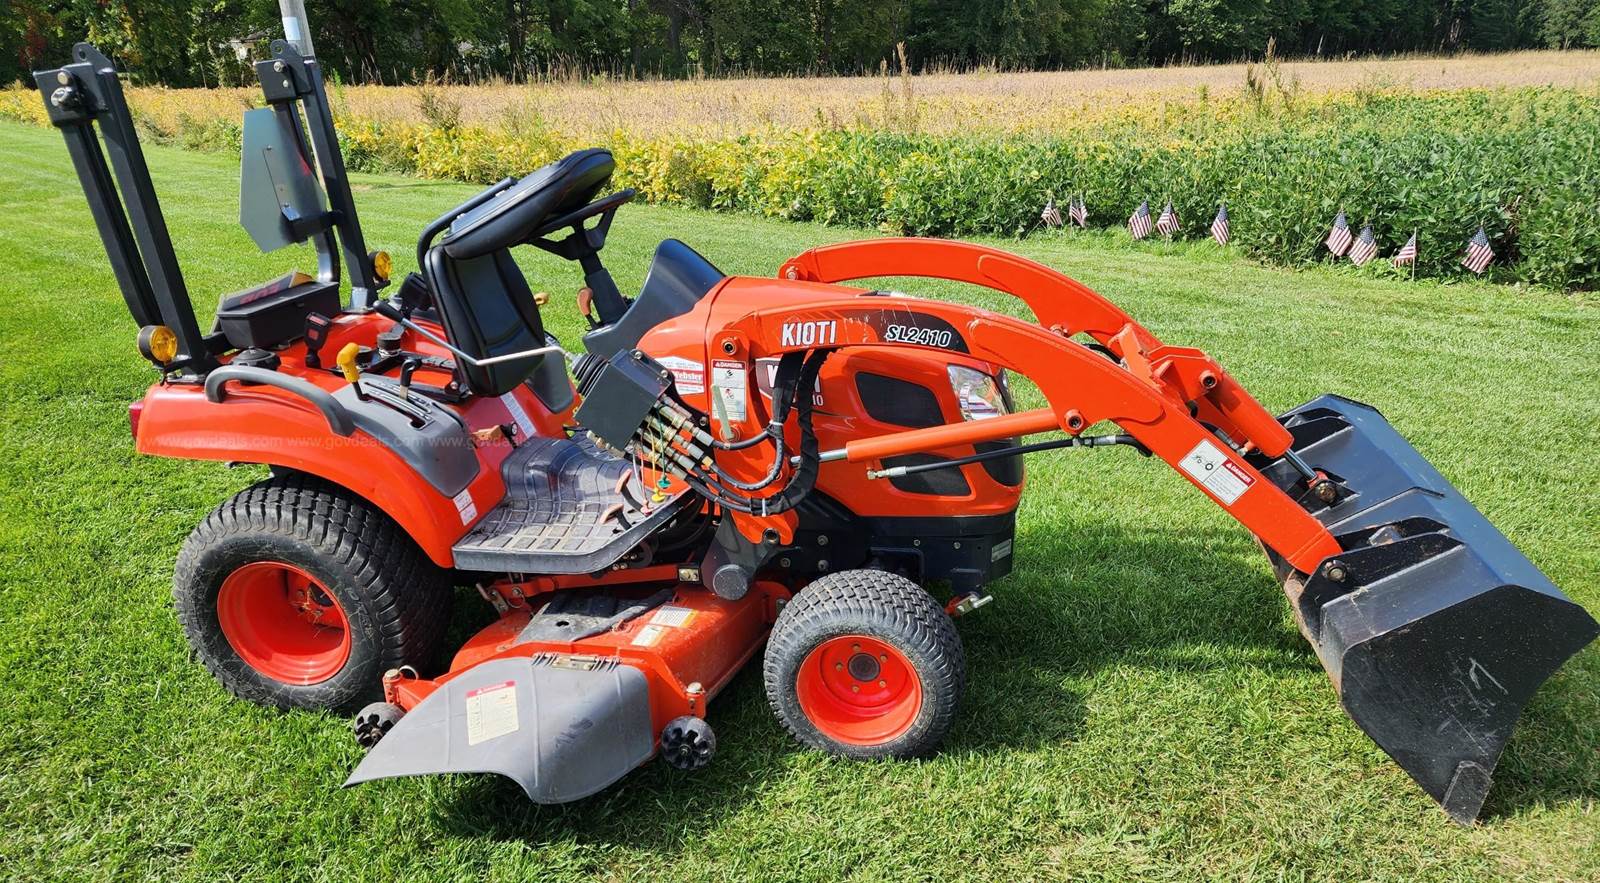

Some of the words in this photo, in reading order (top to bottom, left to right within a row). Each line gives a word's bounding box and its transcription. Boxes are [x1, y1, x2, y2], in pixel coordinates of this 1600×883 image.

[781, 320, 837, 347] KIOTI
[885, 324, 952, 348] SL2410
[1230, 465, 1252, 484] DANGER
